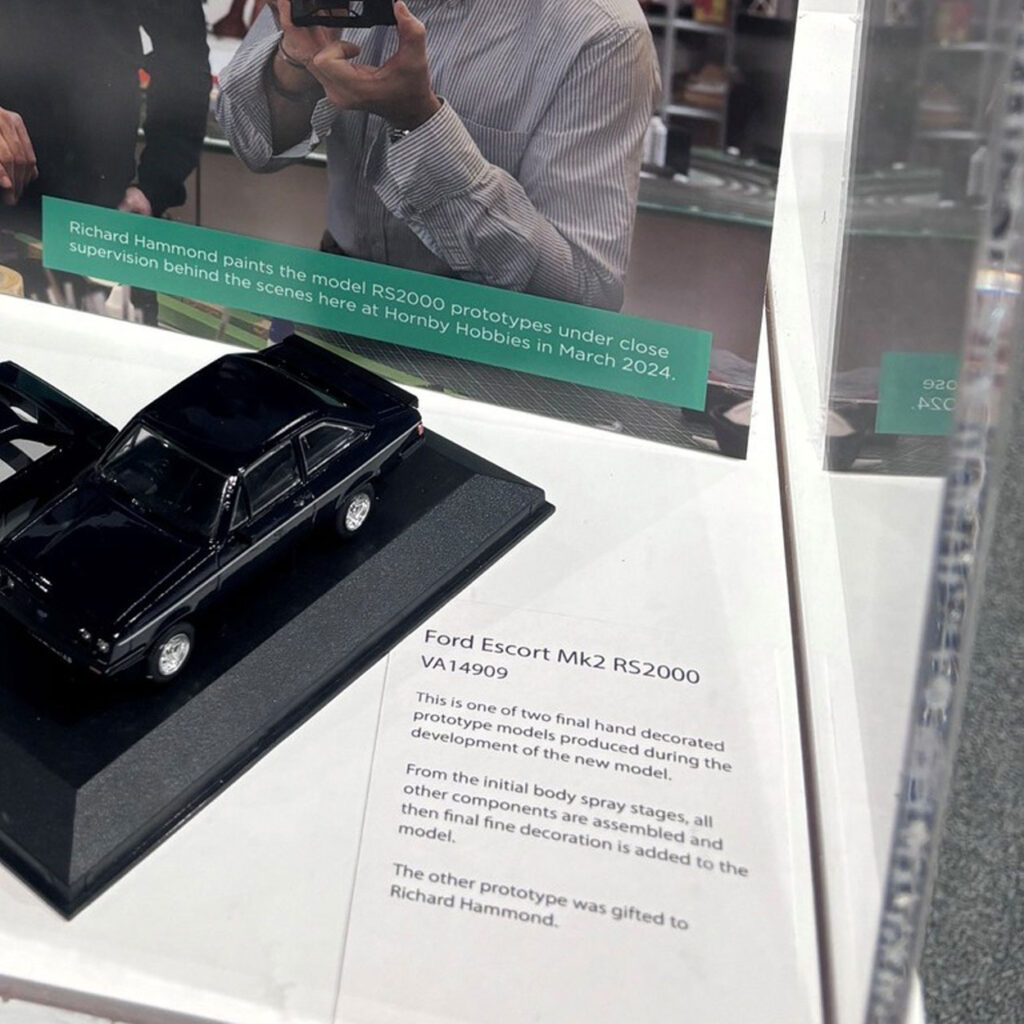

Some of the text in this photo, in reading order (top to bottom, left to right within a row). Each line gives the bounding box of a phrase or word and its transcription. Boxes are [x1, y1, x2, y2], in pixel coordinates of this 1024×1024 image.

[69, 220, 669, 358] Richard Hammond paints the model RS2000 prototypes under close
[69, 241, 675, 380] supervision behind the scenes here at Hornby Hobbies in March 2024.
[421, 655, 508, 679] VA14909
[424, 629, 700, 684] Ford Escort Mk2 RS2000
[413, 711, 732, 772] prototype models produced during the
[416, 691, 725, 752] This is one of two final hand decorated
[410, 727, 672, 780] development of the new model.
[403, 784, 723, 851] other components are assembled and
[406, 763, 713, 828] From the initial body spray stages, all
[398, 824, 455, 843] model.
[401, 802, 748, 877] then final fine decoration is added to the
[390, 884, 558, 927] Richard Hammond.
[393, 862, 689, 930] The other prototype was gifted to
